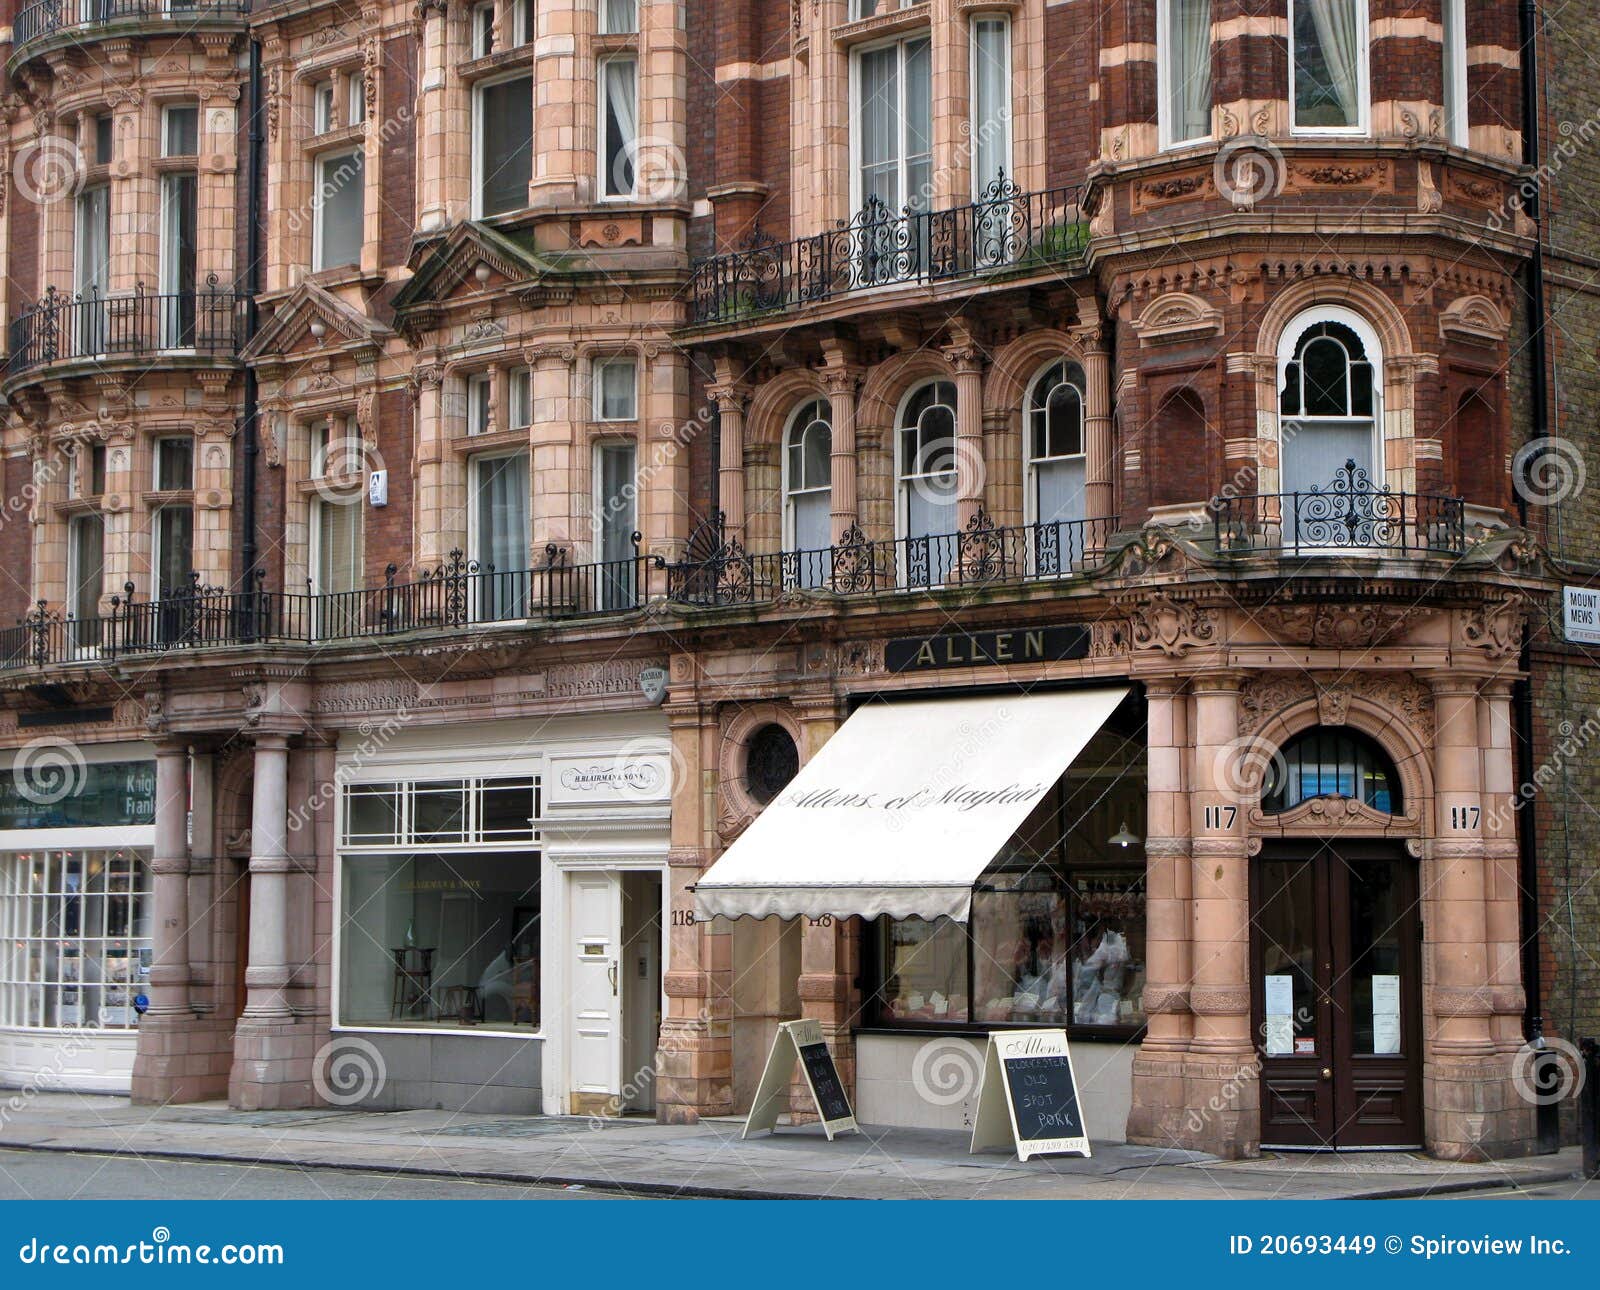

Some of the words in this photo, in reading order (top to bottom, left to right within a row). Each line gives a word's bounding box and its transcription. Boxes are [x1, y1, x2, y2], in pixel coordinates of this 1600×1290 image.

[1570, 592, 1597, 608] MOUNT
[1570, 609, 1593, 624] MEWS
[916, 631, 1044, 665] ALLEN
[779, 788, 877, 809] Allens
[884, 788, 930, 809] of
[936, 783, 1048, 812] Mayfair
[1205, 806, 1238, 830] 117
[1452, 807, 1480, 829] 117
[671, 910, 695, 926] 118
[1007, 1036, 1062, 1055] Allens
[1024, 1074, 1048, 1087] OLD
[1024, 1093, 1053, 1108] SPOT
[1038, 1111, 1074, 1128] PORK
